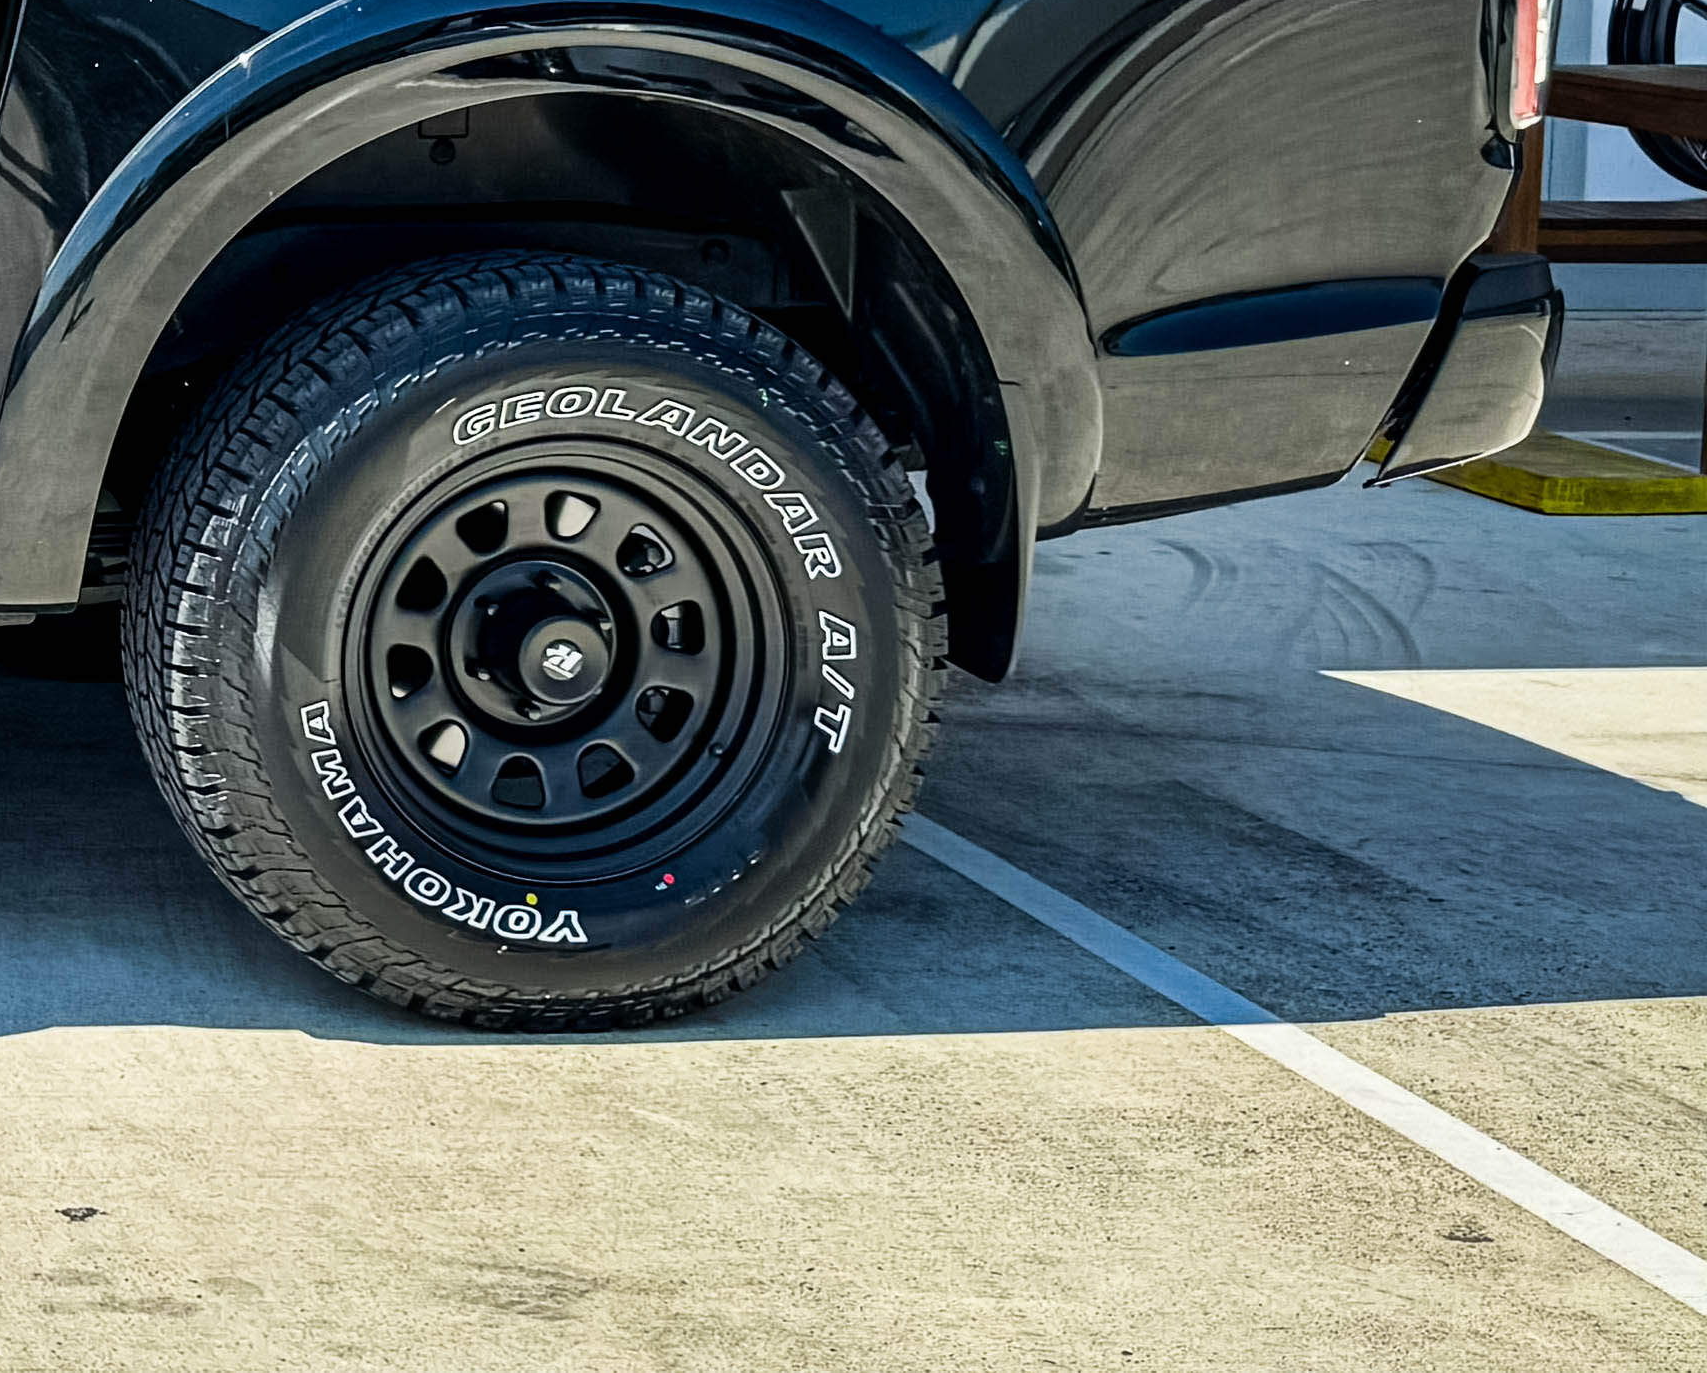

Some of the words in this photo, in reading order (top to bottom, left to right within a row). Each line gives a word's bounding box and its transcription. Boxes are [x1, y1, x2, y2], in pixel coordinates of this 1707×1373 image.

[452, 385, 843, 581] GEOLANDAR
[813, 610, 858, 755] A/T
[300, 699, 589, 944] YOKOHAMA
